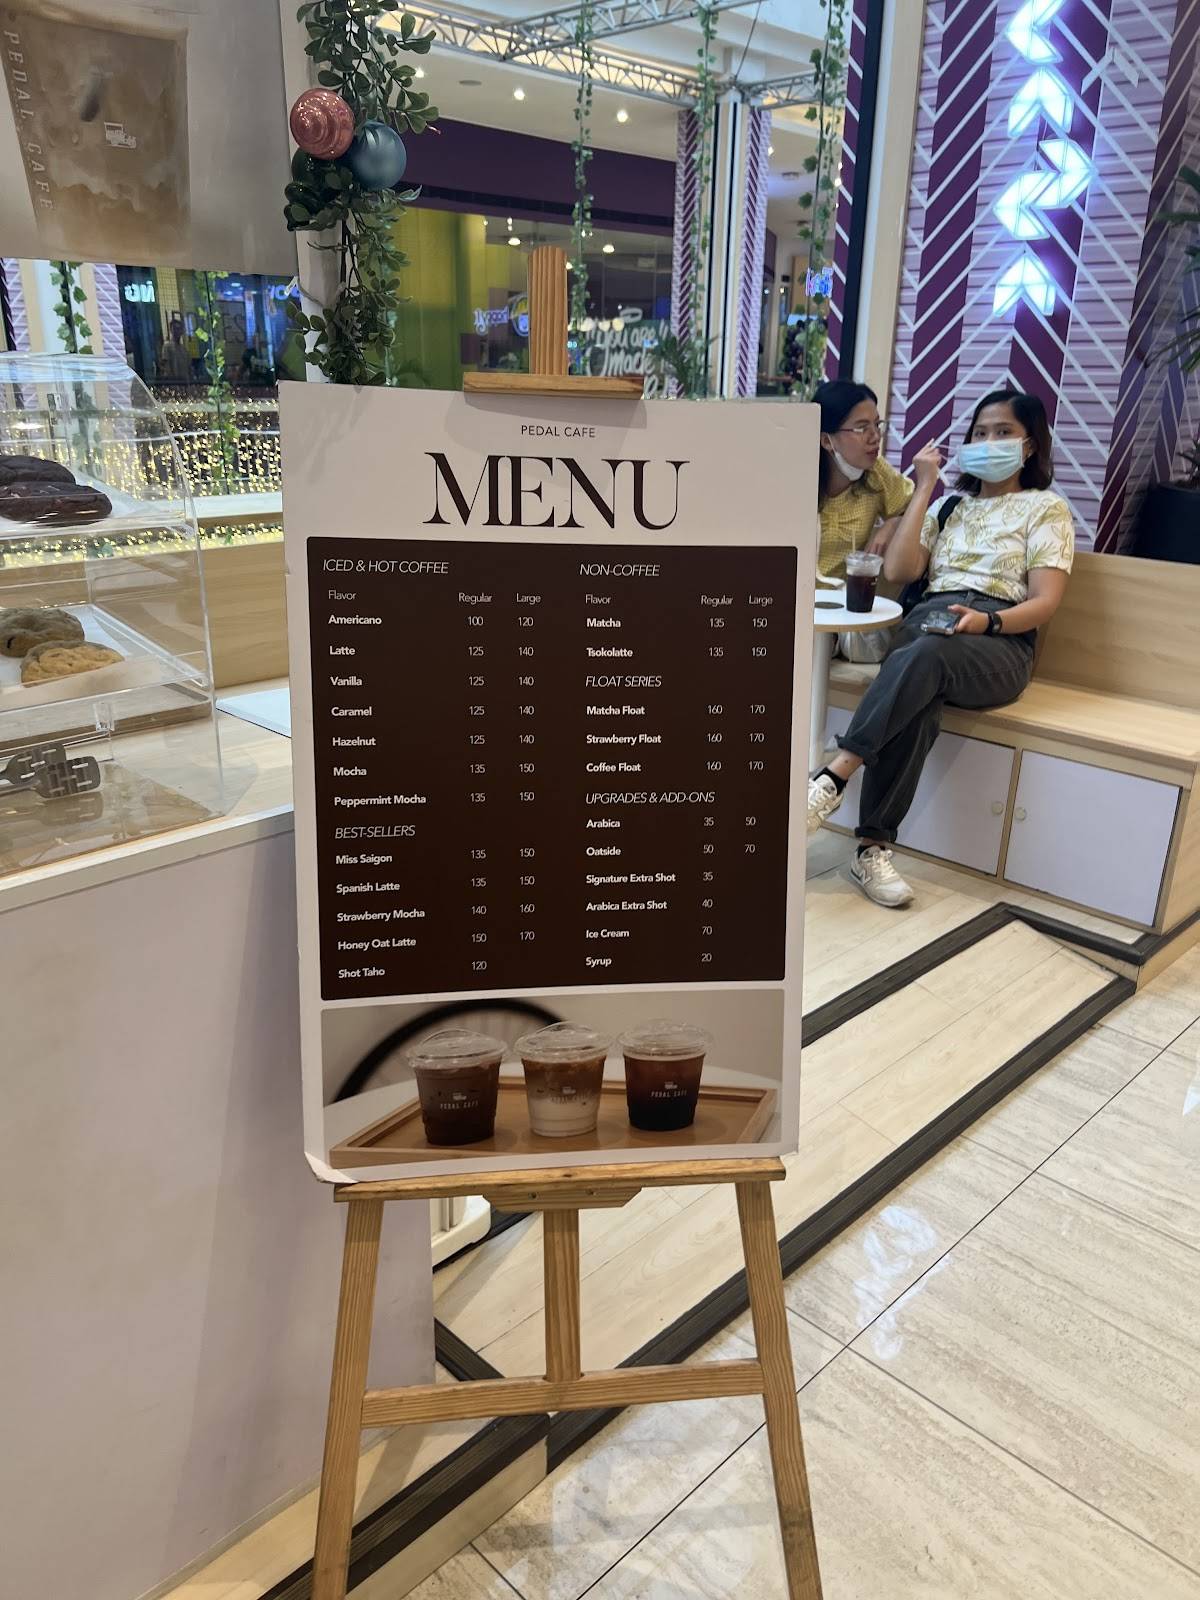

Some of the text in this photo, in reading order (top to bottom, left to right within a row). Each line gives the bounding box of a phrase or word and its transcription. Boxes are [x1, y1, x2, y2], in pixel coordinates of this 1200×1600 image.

[4, 30, 54, 209] PEDAL CAFE
[522, 425, 595, 437] PEDAL CAFE
[423, 452, 690, 530] MENU
[323, 559, 448, 573] ICED & HOT COFFEE
[580, 564, 660, 576] NON-COFFEE
[329, 590, 541, 605] Flavor Regular Large
[586, 594, 772, 607] Flavor Regular Large
[329, 615, 533, 626] Americano 100 120
[587, 618, 767, 627] Matcha 135 150
[330, 646, 533, 656] Latte 125 140
[587, 647, 766, 657] Tsokolatte 135 150
[330, 676, 534, 686] Vanilla 125 140
[586, 676, 661, 687] FLOAT SERIES
[332, 706, 534, 716] Caramel 125 140
[587, 705, 765, 715] Matcha Float 160 170
[333, 735, 534, 746] Hazelnut 125 140
[587, 733, 764, 745] Strawberry Float 160 170
[334, 763, 534, 776] Mocha 135 150
[586, 761, 763, 772] Coffee Float 160 170
[335, 792, 534, 807] Peppermint Mocha 135 150
[586, 792, 715, 804] UPGRADES & ADD-ONS
[586, 817, 756, 828] Arabica 35 50
[335, 825, 415, 838] BEST-SELLERS
[586, 844, 755, 856] Oatside 50 70
[336, 848, 535, 865] Miss Saigon 135 150
[586, 872, 713, 886] Signature Extra Shot 35
[336, 876, 535, 895] Spanish Latte 135 150
[586, 899, 713, 911] Arabica Extra Shot 40
[337, 904, 535, 921] Strawberry Mocha 140 160
[586, 926, 712, 938] Ice Cream 70
[338, 931, 535, 951] Honey Oat Latte 150 170
[586, 953, 712, 967] Syrup 20
[339, 961, 487, 978] Shot Taho 120
